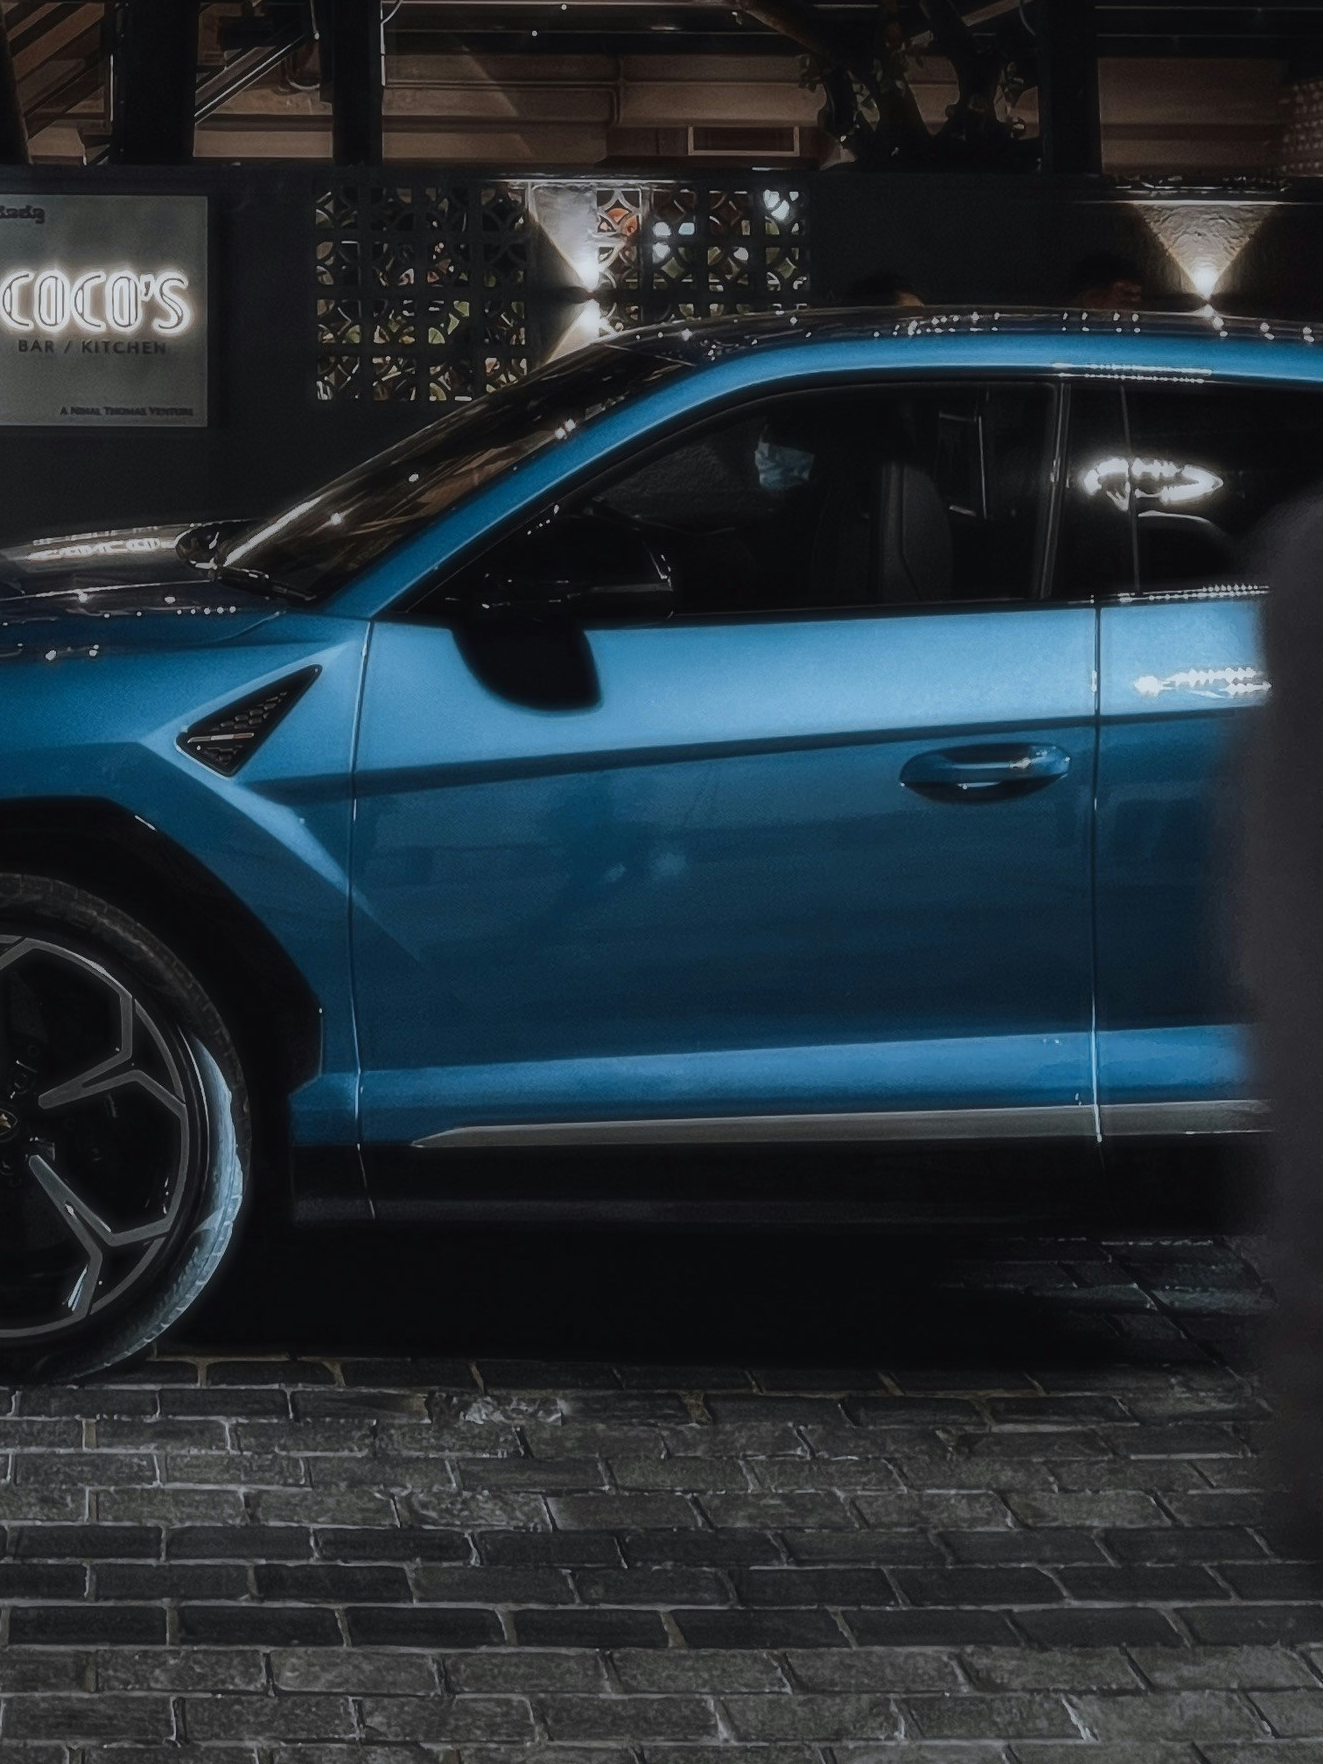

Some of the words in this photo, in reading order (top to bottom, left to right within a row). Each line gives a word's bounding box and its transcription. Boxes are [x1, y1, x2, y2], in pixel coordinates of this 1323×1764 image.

[0, 269, 189, 332] COCO'S
[17, 339, 55, 354] BAR
[81, 340, 167, 355] KITCHEN
